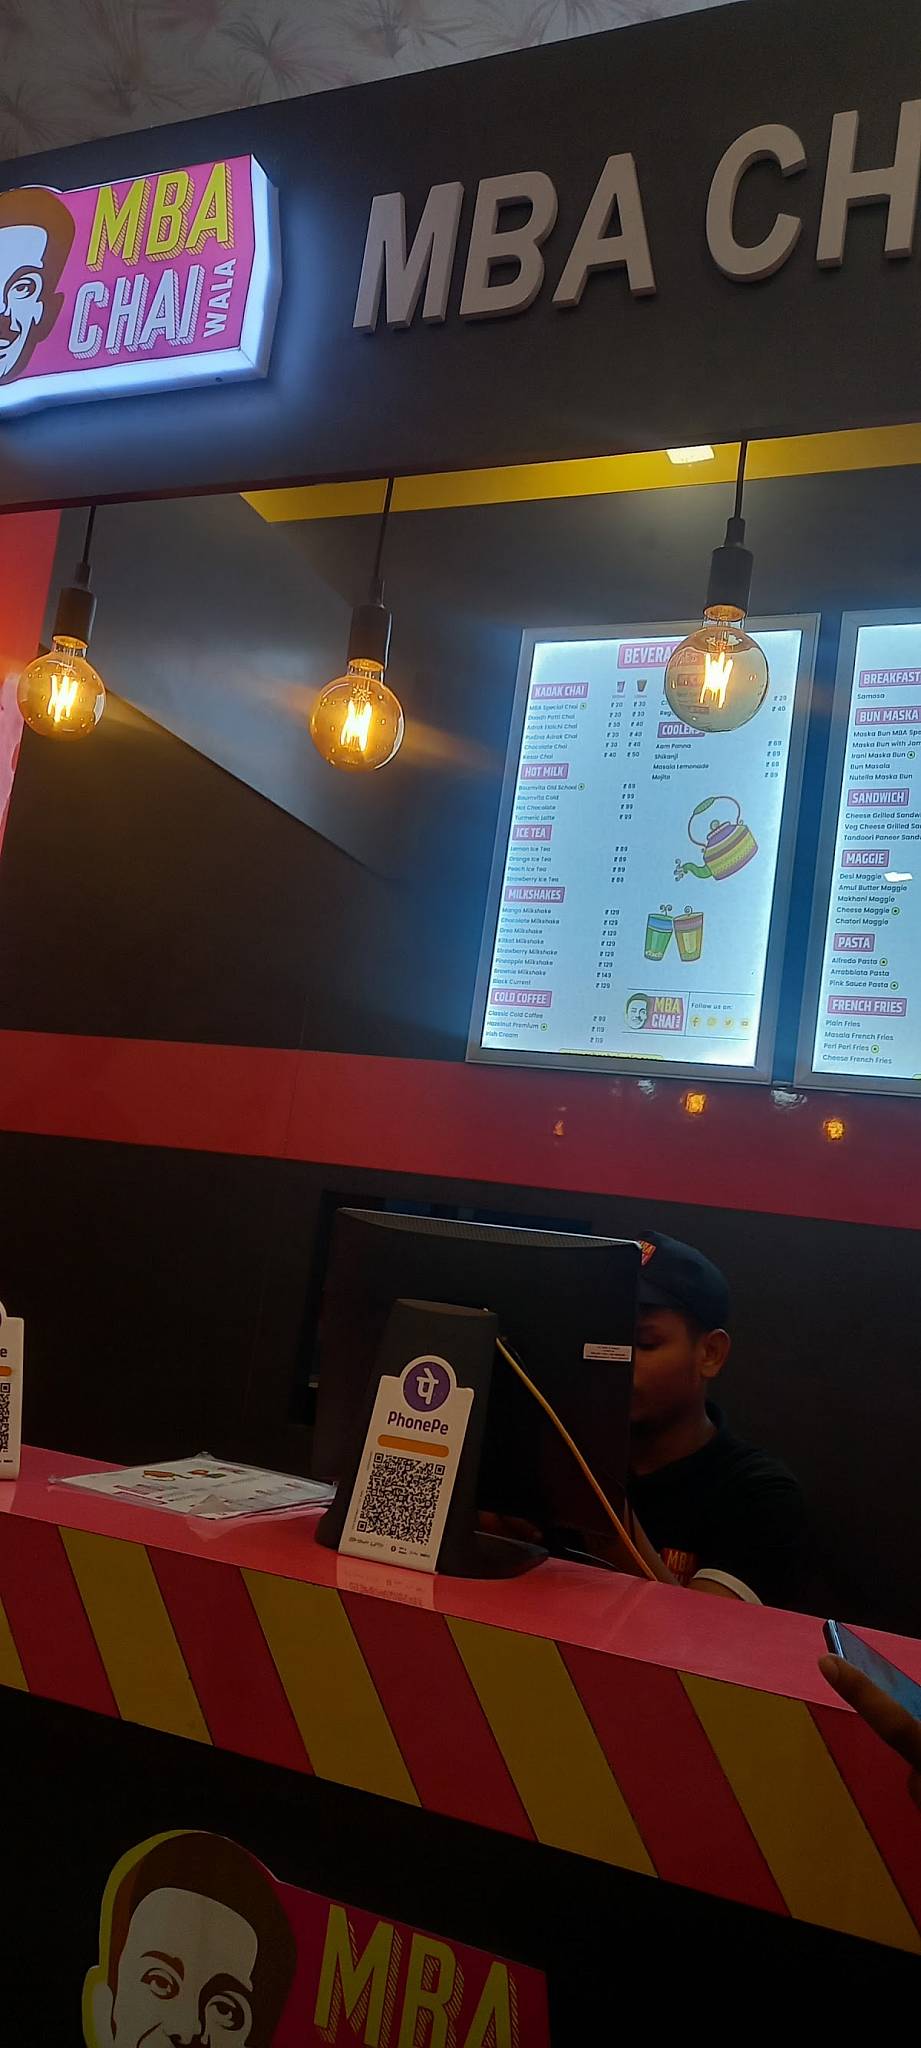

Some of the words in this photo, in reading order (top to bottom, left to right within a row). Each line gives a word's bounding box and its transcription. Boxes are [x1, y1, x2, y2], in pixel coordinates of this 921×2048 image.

[86, 162, 236, 273] MBA
[353, 152, 656, 334] MBA
[706, 99, 921, 283] CH
[69, 264, 204, 360] CHAI
[203, 258, 237, 338] WALA
[623, 646, 673, 664] BEVERA
[864, 672, 921, 684] BREAKFAST
[535, 686, 564, 697] KADAK
[564, 685, 585, 696] CHAI
[859, 711, 880, 722] BUN
[883, 709, 919, 721] MASKA
[525, 767, 542, 777] HOT
[543, 766, 564, 777] MILK
[852, 791, 905, 804] SANDWICH
[516, 827, 529, 838] ICE
[530, 827, 546, 838] TEA
[846, 852, 885, 864] MAGGIE
[856, 873, 882, 881] Maggie
[508, 889, 561, 900] MILKSHAKES
[881, 885, 907, 893] Maggie
[869, 896, 895, 904] Maggie
[864, 907, 890, 915] Maggie
[863, 918, 889, 926] Maggie
[838, 937, 870, 948] PASTA
[494, 992, 515, 1003] COLD
[516, 993, 547, 1004] COFFEE
[654, 997, 679, 1014] MBA
[832, 1000, 871, 1012] FRENCH
[874, 1001, 903, 1013] FRIES
[651, 1014, 675, 1028] CHAI
[850, 1055, 874, 1063] French
[875, 1056, 892, 1064] Fries
[387, 1410, 449, 1435] PhonePe
[313, 1903, 520, 2048] MBA
